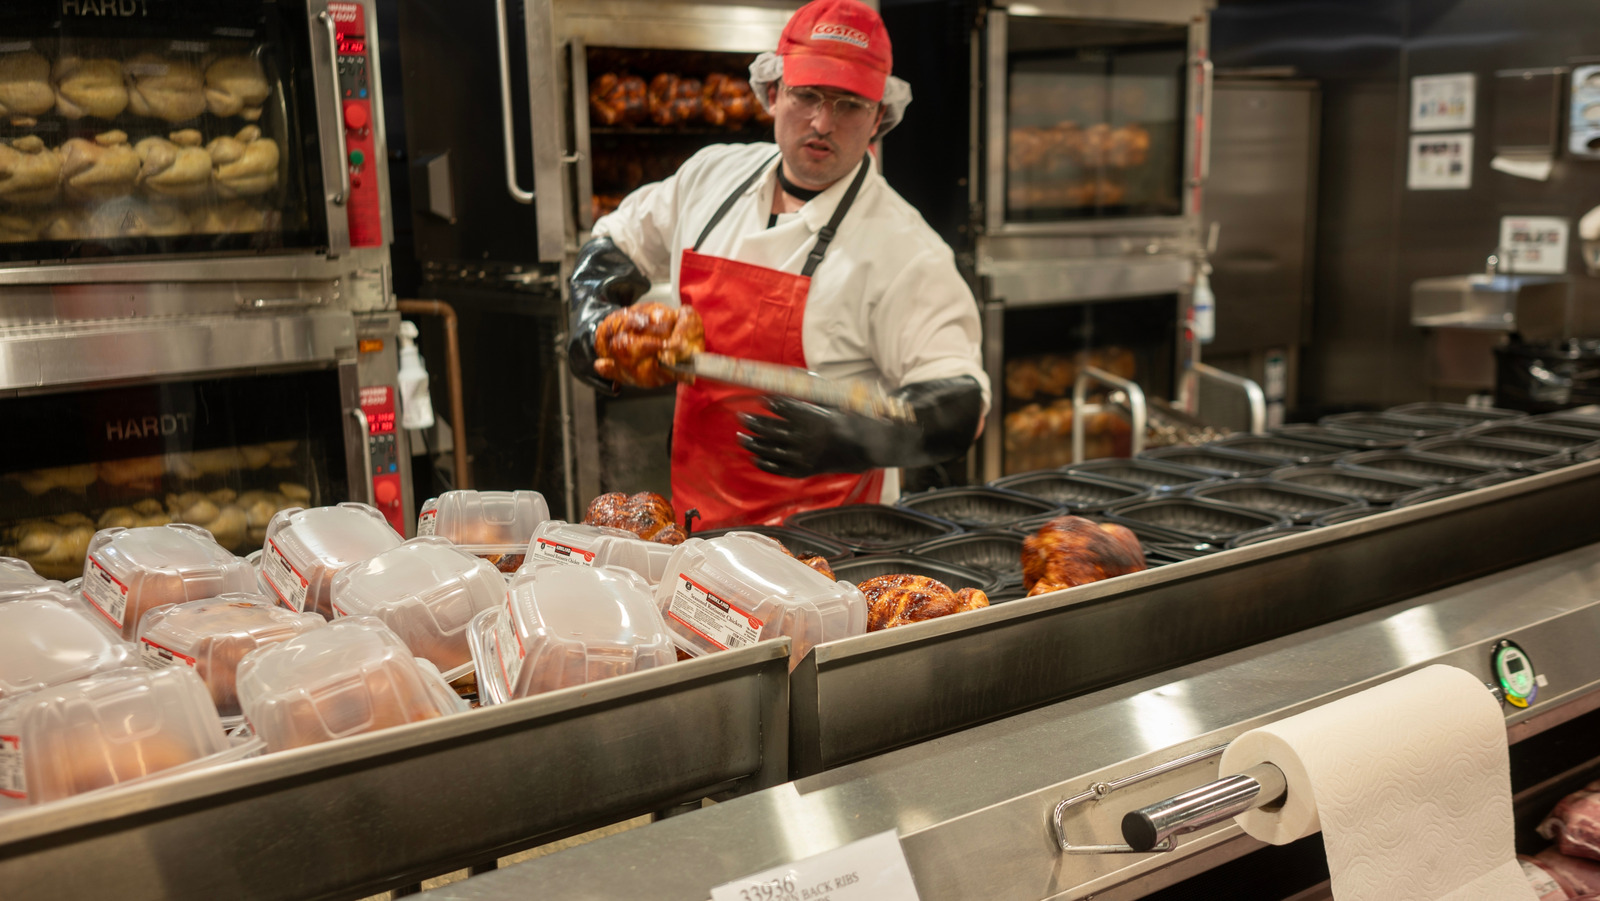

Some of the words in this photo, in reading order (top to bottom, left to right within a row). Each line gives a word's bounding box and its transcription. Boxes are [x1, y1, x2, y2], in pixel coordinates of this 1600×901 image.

[814, 24, 868, 42] COSTCO
[106, 412, 192, 440] HARDT
[726, 614, 743, 628] Chicken
[740, 874, 795, 901] 33936
[802, 880, 833, 900] BACK
[834, 871, 859, 889] RIBS
